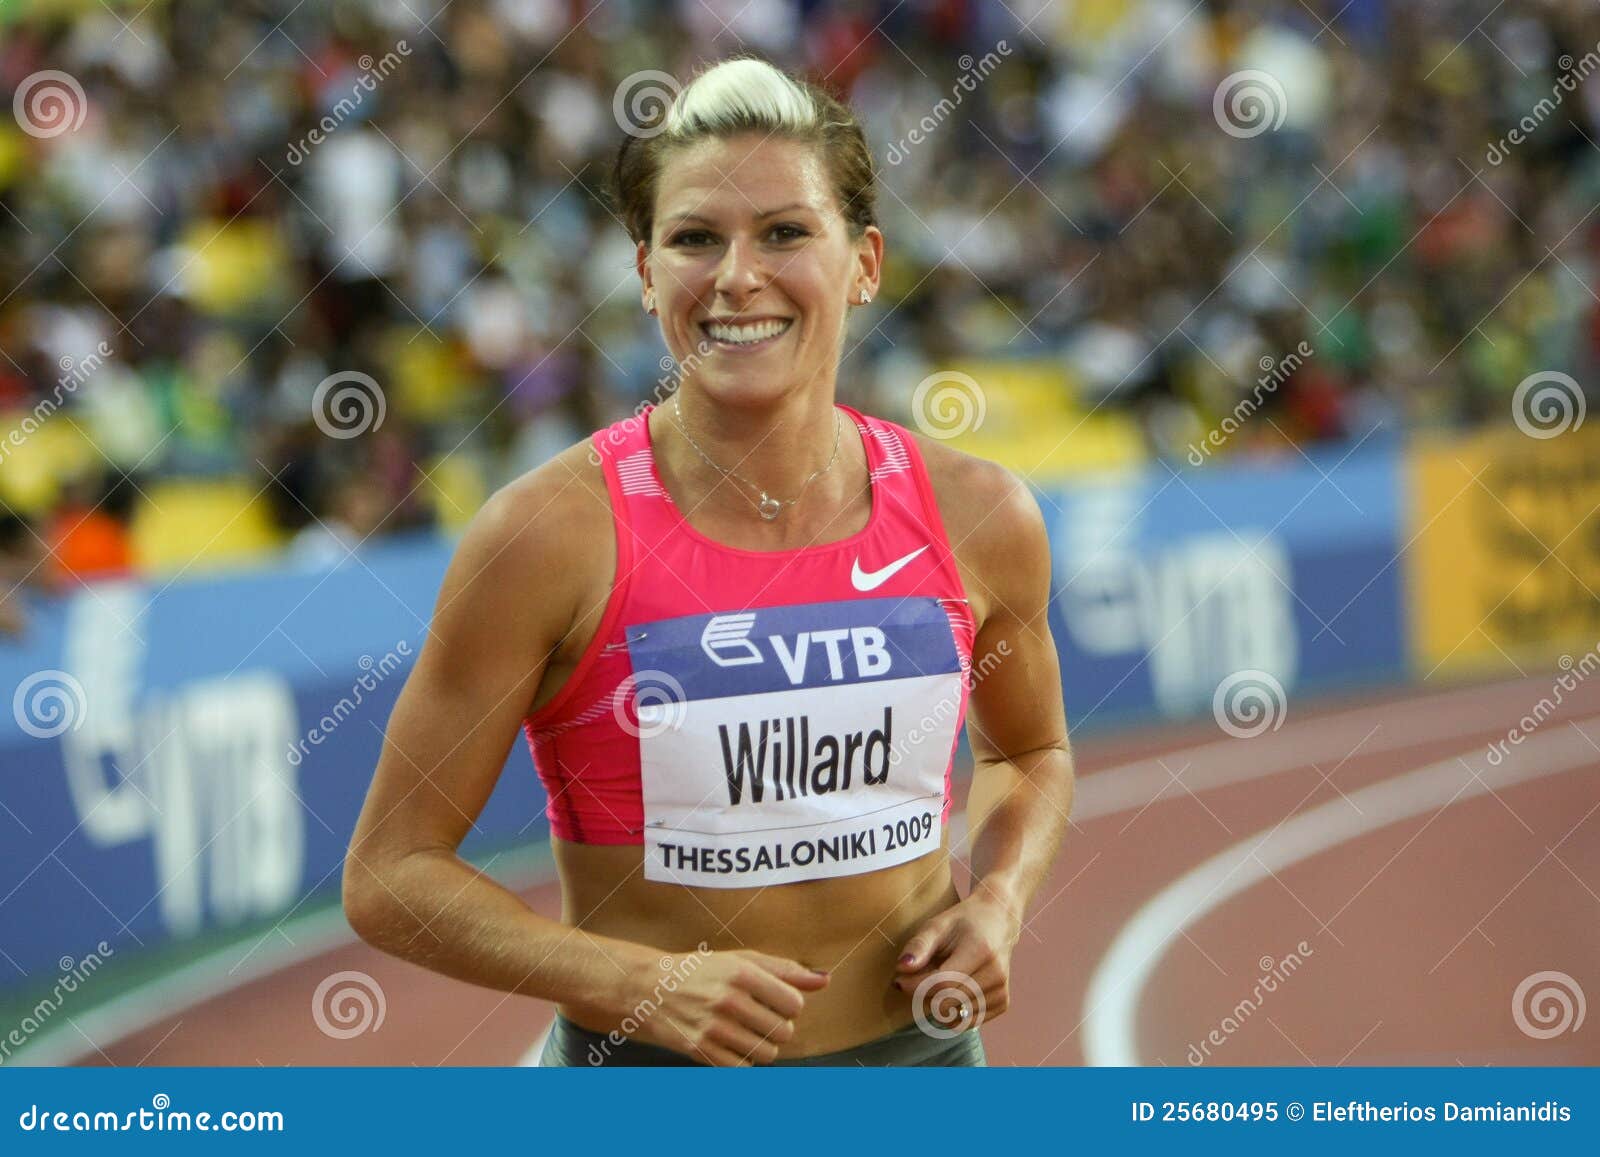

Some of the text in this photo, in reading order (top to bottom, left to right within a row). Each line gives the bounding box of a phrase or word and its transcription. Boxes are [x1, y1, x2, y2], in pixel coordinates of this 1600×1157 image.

[768, 626, 892, 685] VTB
[718, 706, 893, 806] Willard
[657, 811, 932, 874] THESSALONIKI 2009
